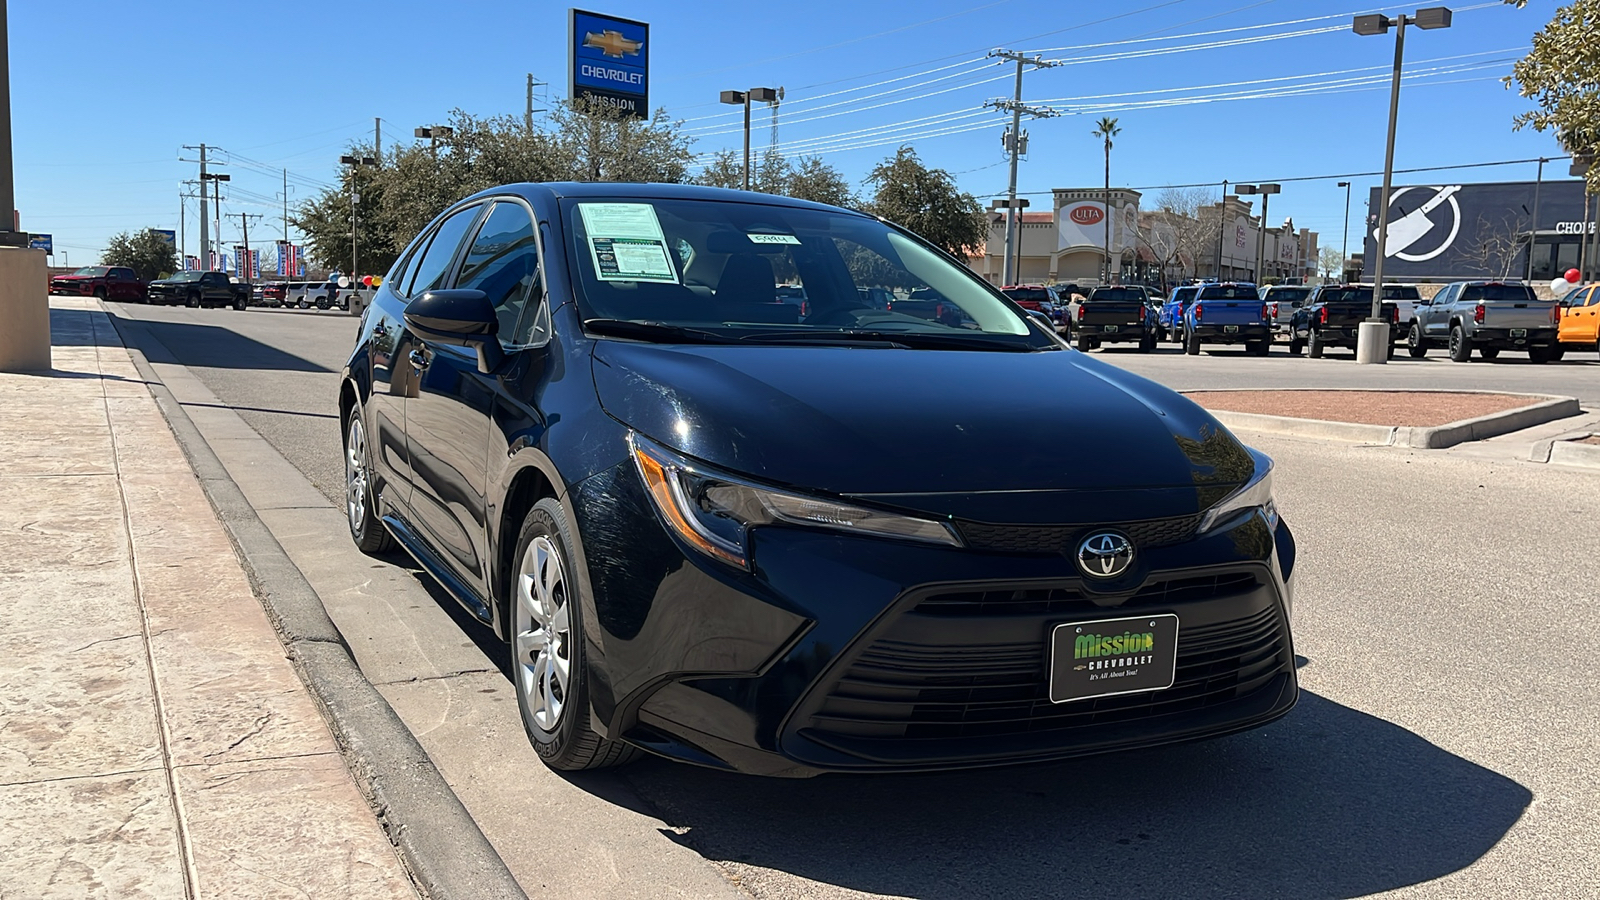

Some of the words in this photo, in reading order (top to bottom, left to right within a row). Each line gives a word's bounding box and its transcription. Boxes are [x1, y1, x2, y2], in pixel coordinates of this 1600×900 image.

[581, 65, 644, 85] CHEVROLET
[589, 94, 635, 111] MISSION
[1075, 209, 1100, 219] ULTA
[1074, 631, 1154, 659] Mission
[1088, 655, 1153, 671] CHEVROLET
